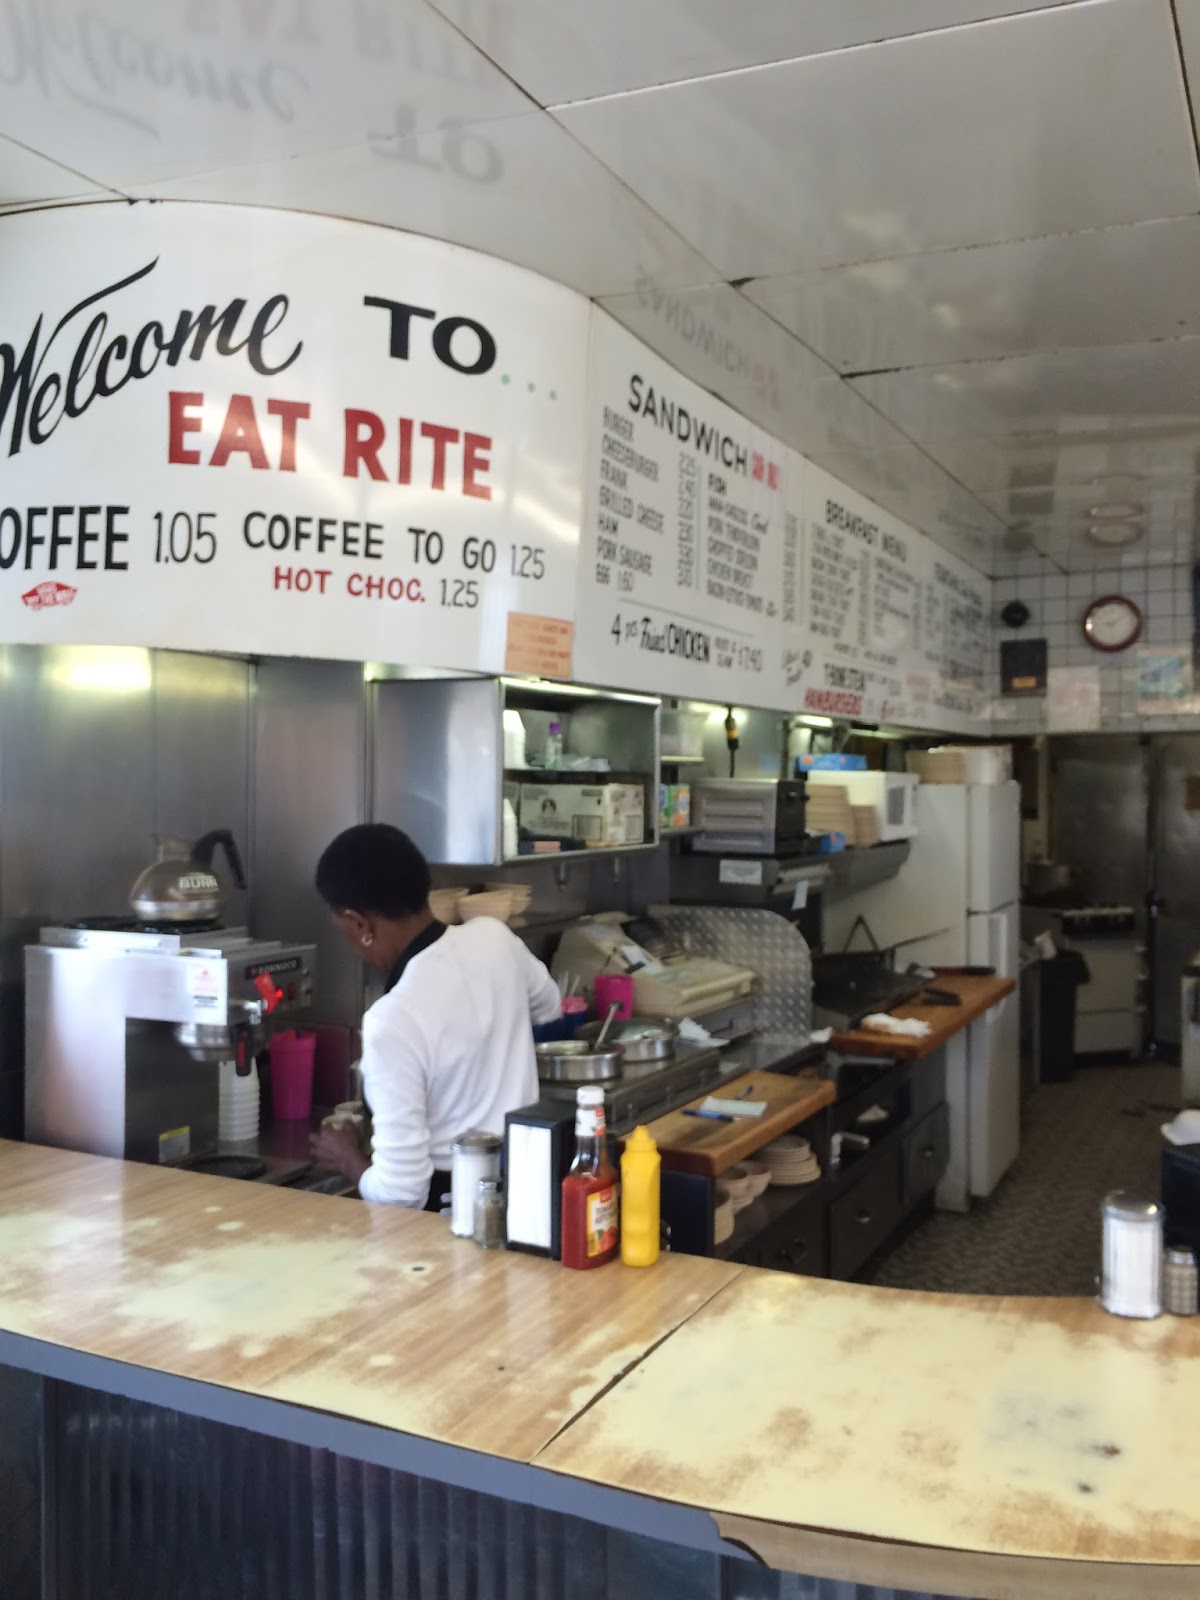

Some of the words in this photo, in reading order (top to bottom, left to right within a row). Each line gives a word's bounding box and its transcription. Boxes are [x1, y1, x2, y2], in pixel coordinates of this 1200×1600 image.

[0, 255, 303, 457] Welcome
[168, 390, 311, 473] EAT
[343, 408, 493, 501] RITE
[628, 374, 748, 478] SANDWICH
[154, 511, 218, 565] 1.05
[243, 511, 384, 560] COFFEE
[407, 527, 444, 566] TO
[462, 536, 497, 573] GO
[509, 544, 546, 580] 1.25
[273, 566, 333, 594] HOT
[440, 578, 480, 609] 1.25
[611, 613, 621, 646] 4
[667, 622, 711, 663] CHICKEN
